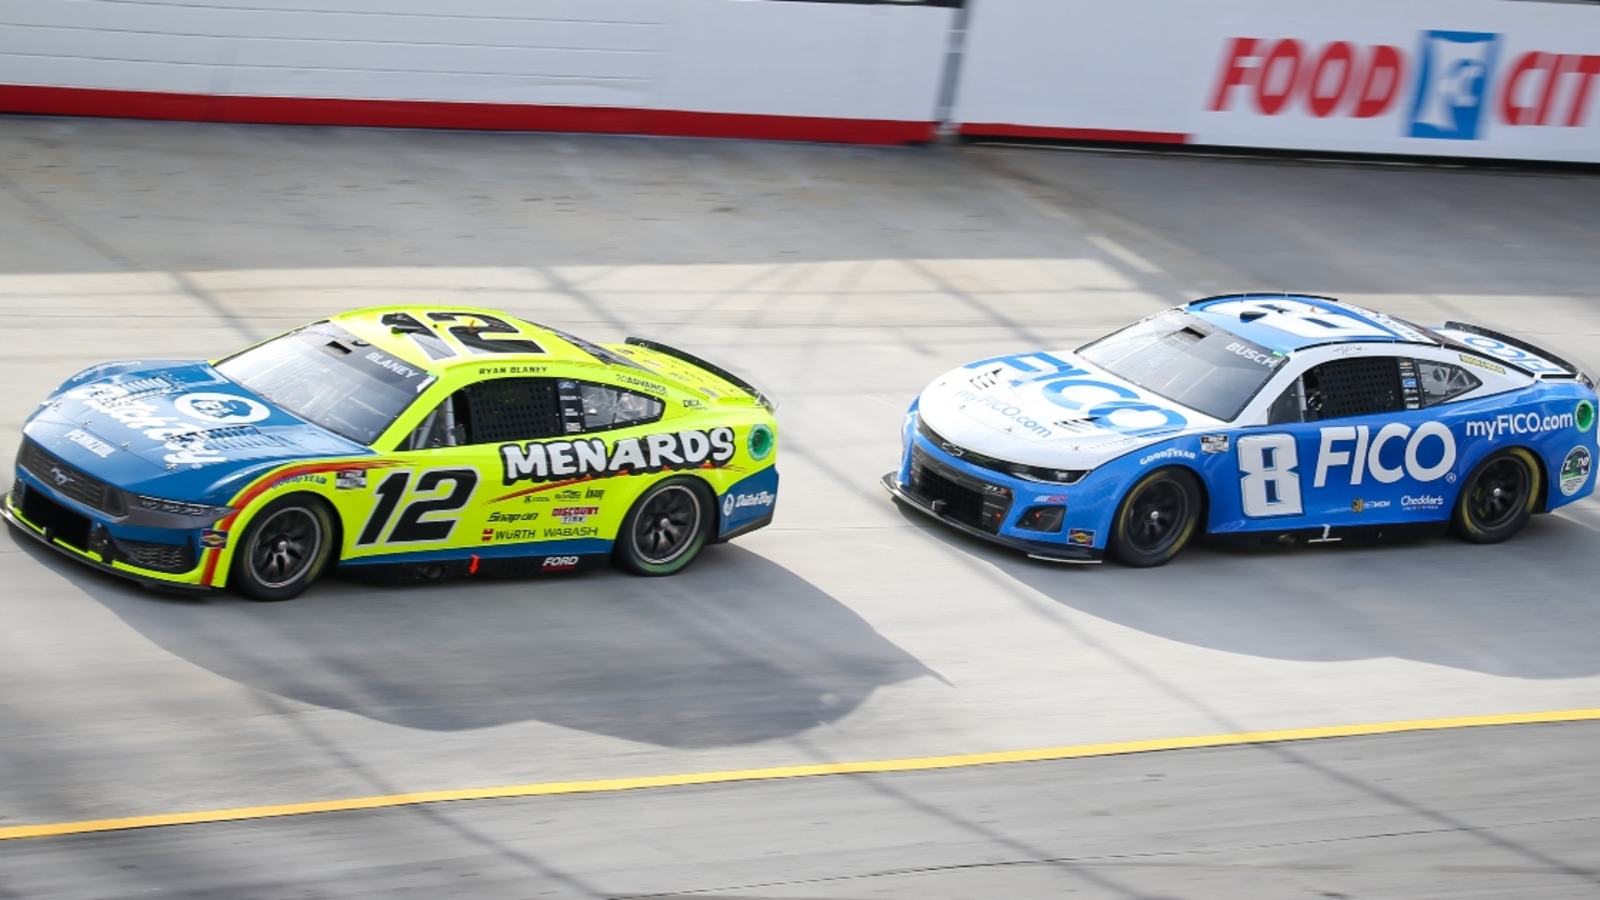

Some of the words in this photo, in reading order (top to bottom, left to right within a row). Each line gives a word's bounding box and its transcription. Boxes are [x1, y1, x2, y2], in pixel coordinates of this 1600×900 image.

[1206, 37, 1408, 119] FOOD
[380, 311, 548, 362] 12
[365, 351, 420, 379] BLANEY
[478, 366, 507, 376] RYAN
[509, 366, 549, 375] BLANEY
[1225, 342, 1280, 371] BUSCH
[963, 351, 1188, 438] FICO
[1466, 412, 1574, 441] myFICO.com
[500, 426, 736, 484] MENARDS
[1313, 420, 1458, 488] FICO
[1236, 432, 1305, 519] 8
[354, 467, 480, 547] 12
[486, 511, 539, 523] Snap-on
[551, 506, 600, 517] DISCOUNT
[543, 526, 599, 538] WABASH
[542, 555, 580, 567] FORD
